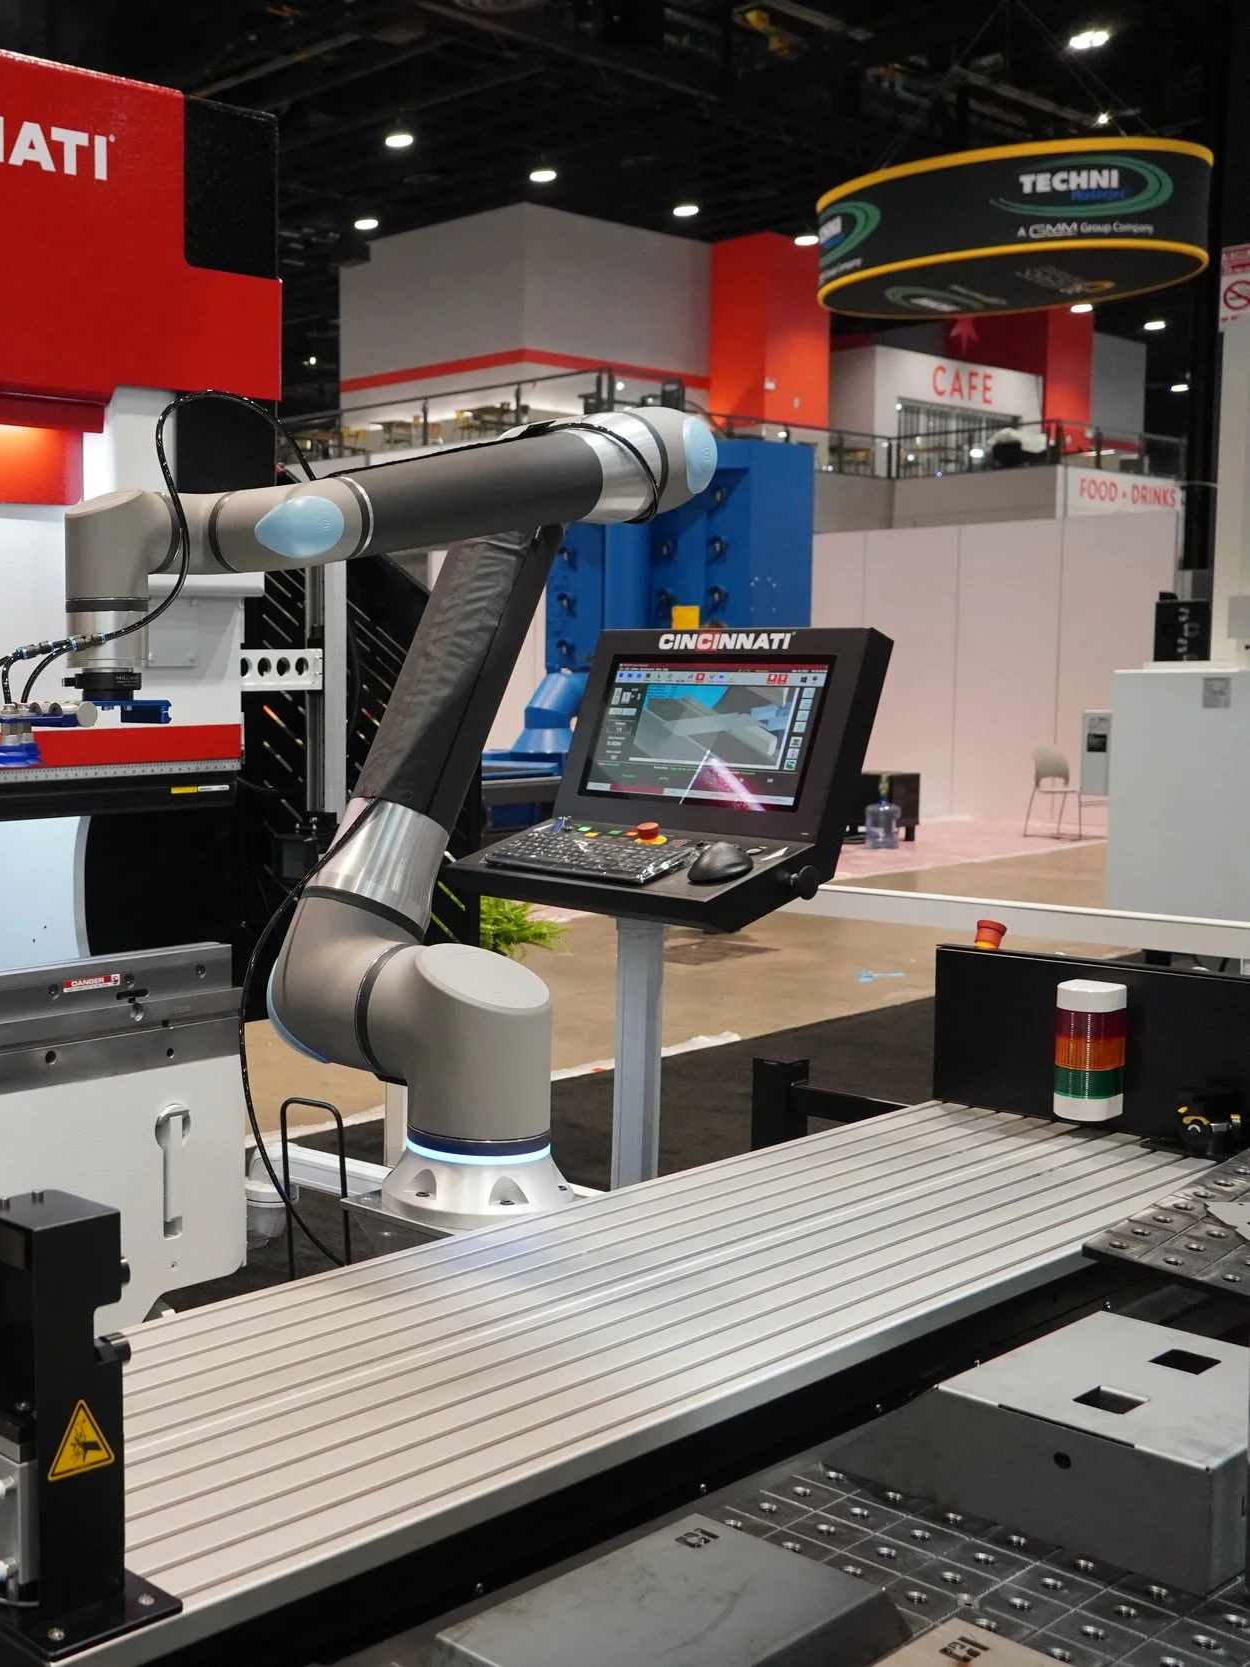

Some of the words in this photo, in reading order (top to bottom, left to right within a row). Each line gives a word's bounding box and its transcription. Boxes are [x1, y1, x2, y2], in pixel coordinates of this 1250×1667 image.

[1019, 168, 1119, 194] TECHNI
[1080, 221, 1111, 235] Group
[932, 365, 993, 405] CAFE
[1079, 478, 1118, 502] FOOD
[1131, 483, 1176, 508] DRINKS
[658, 632, 792, 650] CINCINNATI
[71, 977, 105, 987] DANGER
